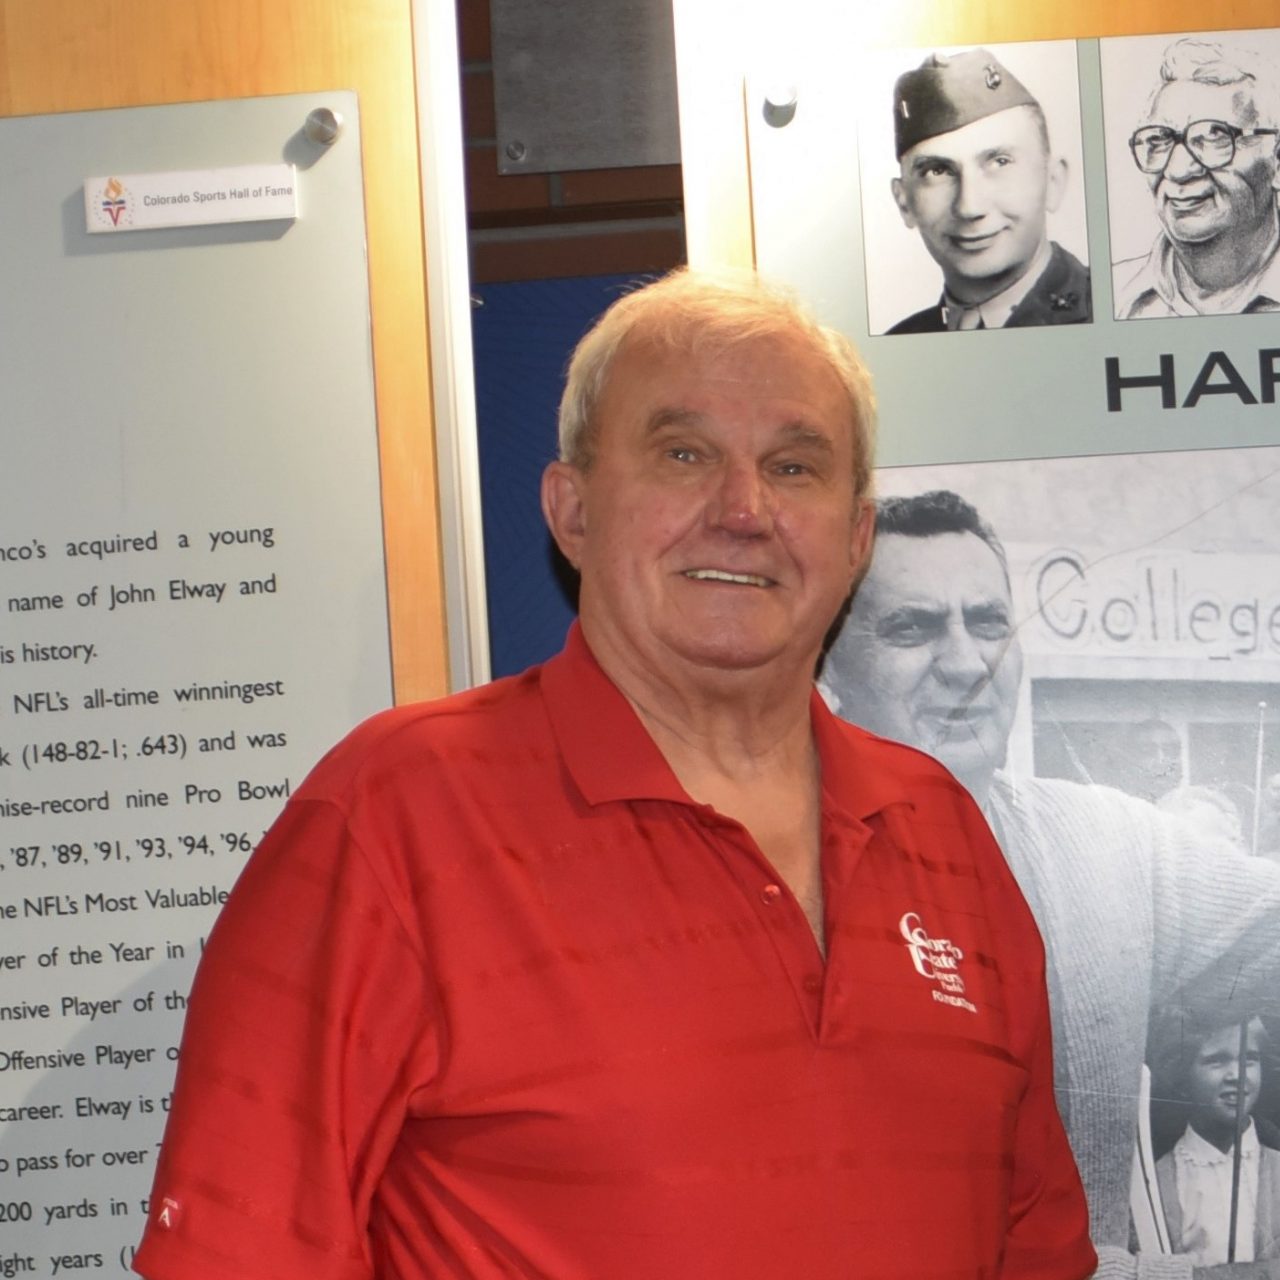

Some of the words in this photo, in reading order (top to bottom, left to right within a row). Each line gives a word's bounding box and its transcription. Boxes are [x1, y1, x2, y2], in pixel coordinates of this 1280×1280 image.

[142, 194, 191, 207] Colorado
[192, 190, 227, 205] Sports
[228, 187, 250, 200] Hall
[251, 186, 263, 198] of
[264, 185, 294, 198] Fame
[66, 529, 159, 561] acquired
[177, 533, 191, 549] a
[208, 527, 276, 553] young
[7, 594, 65, 613] name
[76, 585, 99, 608] of
[108, 582, 156, 612] John
[168, 579, 227, 604] Elway
[239, 572, 278, 596] and
[21, 642, 99, 665] history.
[13, 690, 70, 715] NFL's
[83, 687, 160, 710] all-time
[172, 680, 286, 705] winningest
[21, 738, 128, 771] (148-82-1;
[136, 733, 188, 760] .643)
[198, 729, 237, 753] and
[245, 732, 288, 749] was
[125, 788, 169, 809] nine
[184, 783, 222, 805] Pro
[237, 777, 290, 802] Bowl
[9, 845, 47, 869] '87,
[51, 842, 89, 866] '89,
[93, 840, 131, 863] '91,
[135, 837, 173, 860] '93,
[177, 834, 215, 857] '94,
[23, 894, 79, 918] NFL's
[84, 892, 139, 914] Most
[144, 884, 229, 909] Valuable
[60, 995, 123, 1022] Player
[132, 990, 156, 1013] of
[95, 1044, 157, 1071] Player
[75, 1096, 133, 1121] Elway
[138, 1094, 155, 1114] is
